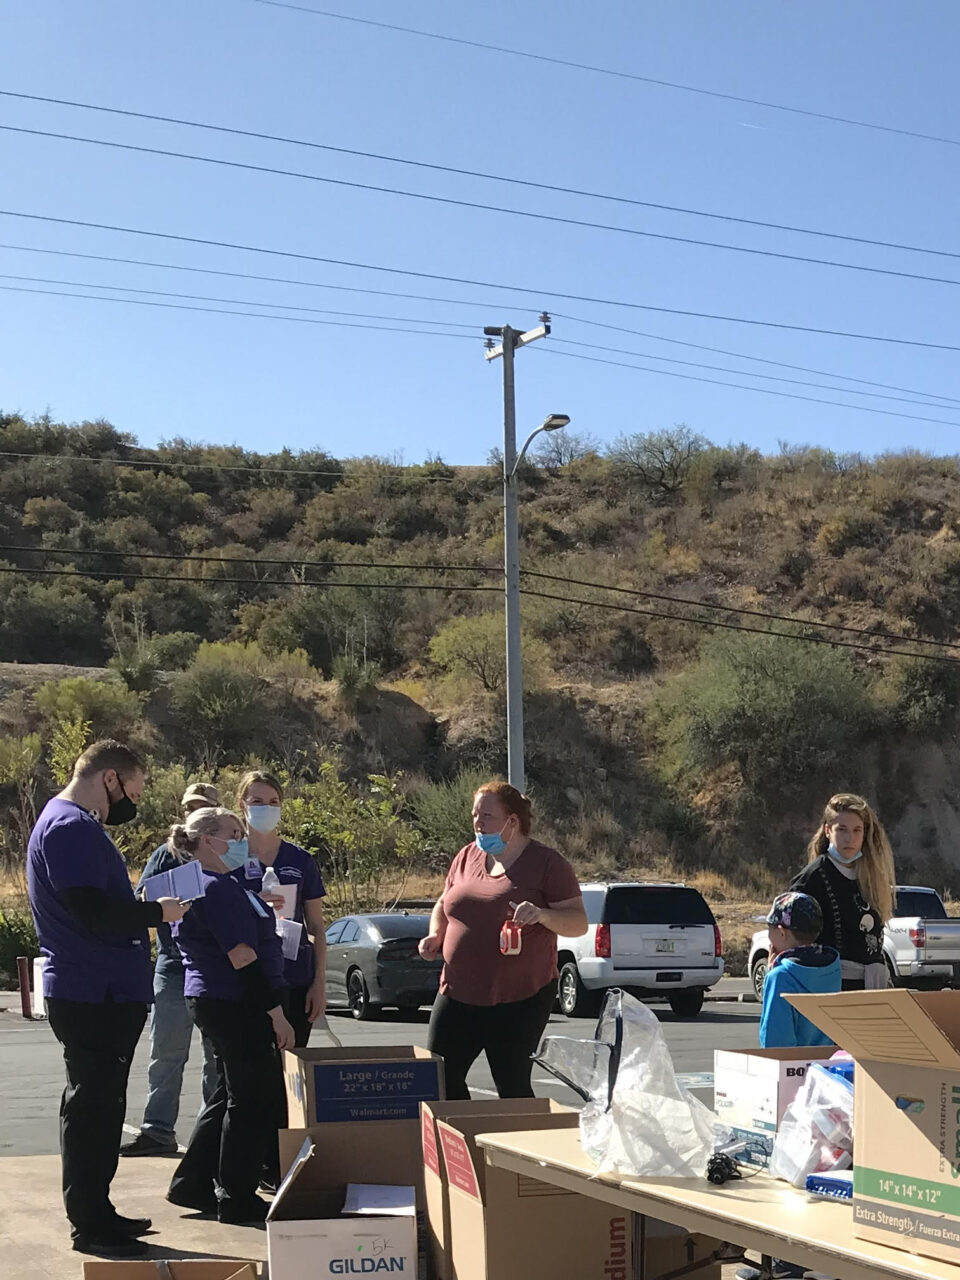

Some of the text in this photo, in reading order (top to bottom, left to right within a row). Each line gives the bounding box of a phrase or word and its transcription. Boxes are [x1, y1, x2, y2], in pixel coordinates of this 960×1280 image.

[339, 1070, 372, 1083] Large
[381, 1070, 415, 1080] Grande
[344, 1083, 361, 1093] 22"
[350, 1107, 407, 1117] Walmart.com
[938, 1140, 947, 1174] EXTRA
[879, 1179, 942, 1204] 14" x 14" x 12"
[855, 1206, 877, 1222] Extra
[876, 1211, 914, 1231] Strength
[919, 1223, 942, 1237] Fuerza
[942, 1229, 960, 1242] Extra
[329, 1257, 404, 1274] GILDAN
